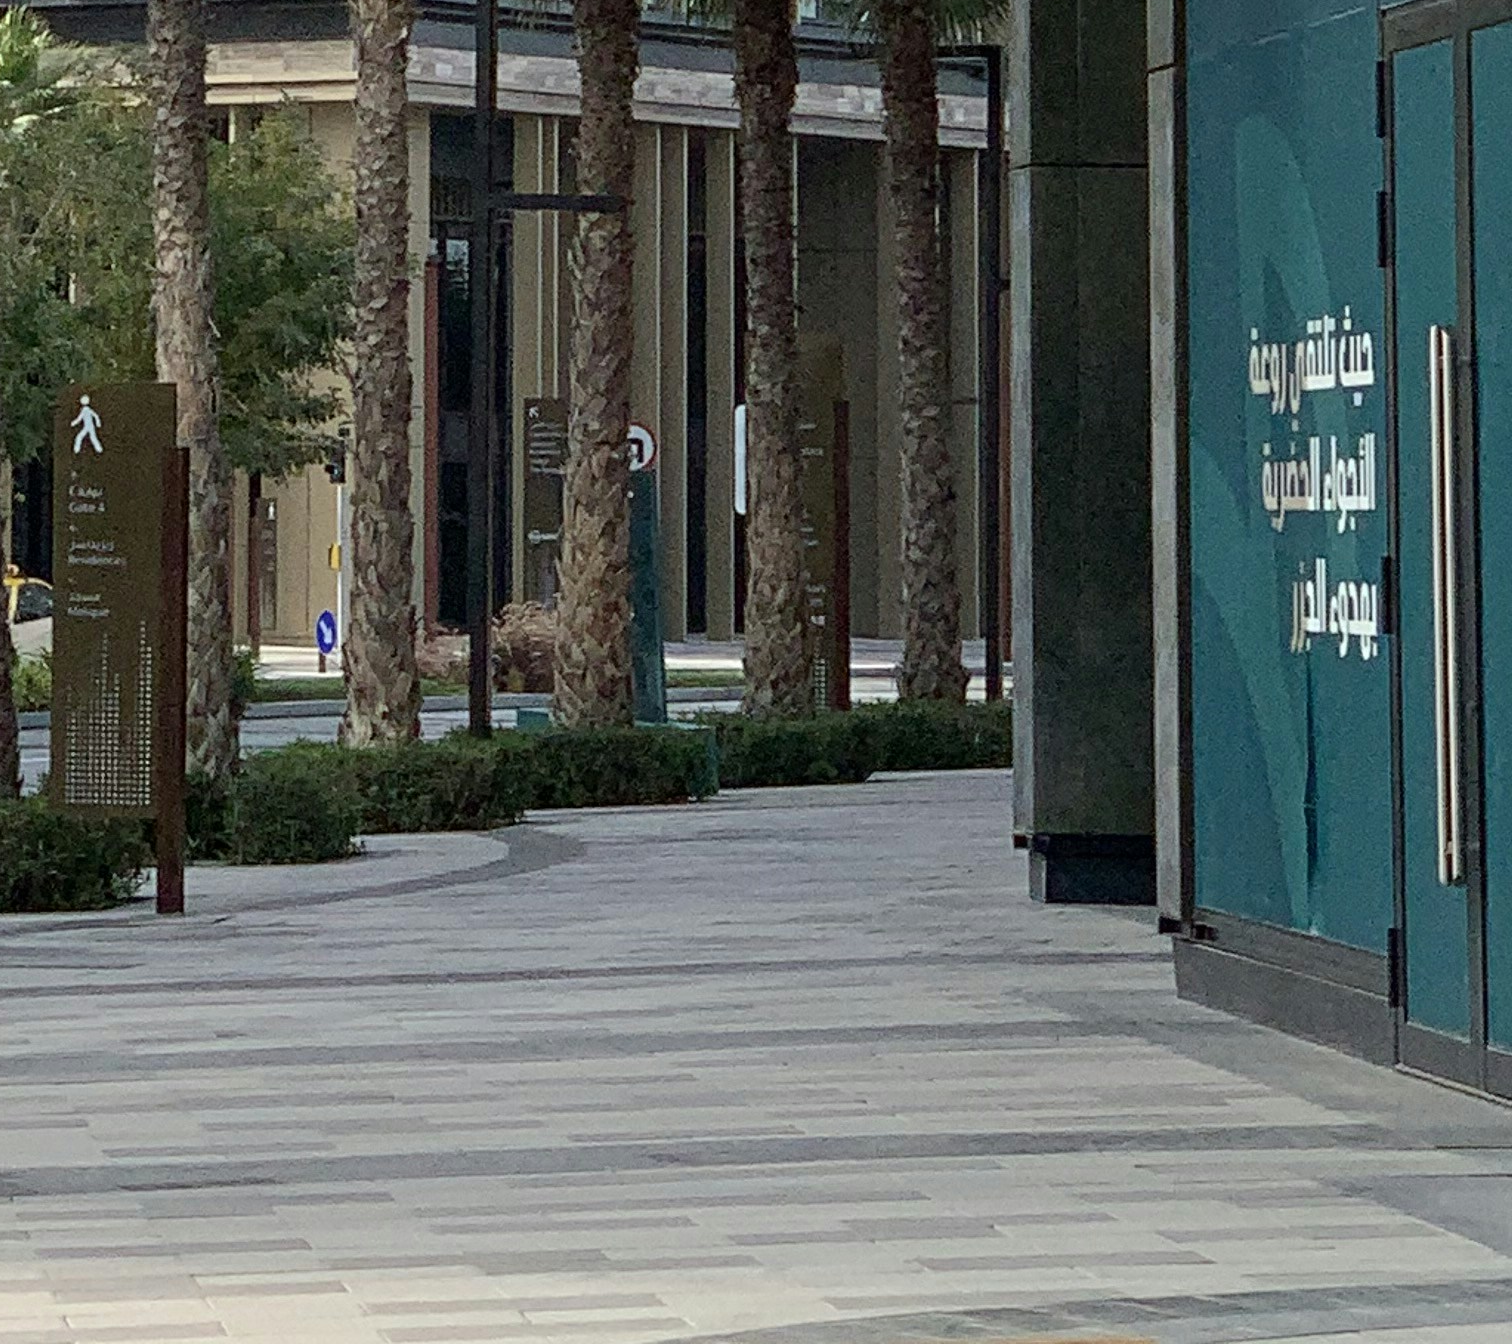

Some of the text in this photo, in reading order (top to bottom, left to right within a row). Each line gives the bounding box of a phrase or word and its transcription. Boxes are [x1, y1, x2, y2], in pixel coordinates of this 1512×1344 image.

[1249, 305, 1374, 432] حيث تلتقي روعة
[1262, 436, 1320, 532] الحضرية
[1291, 558, 1378, 661] بهدوء الجزر
